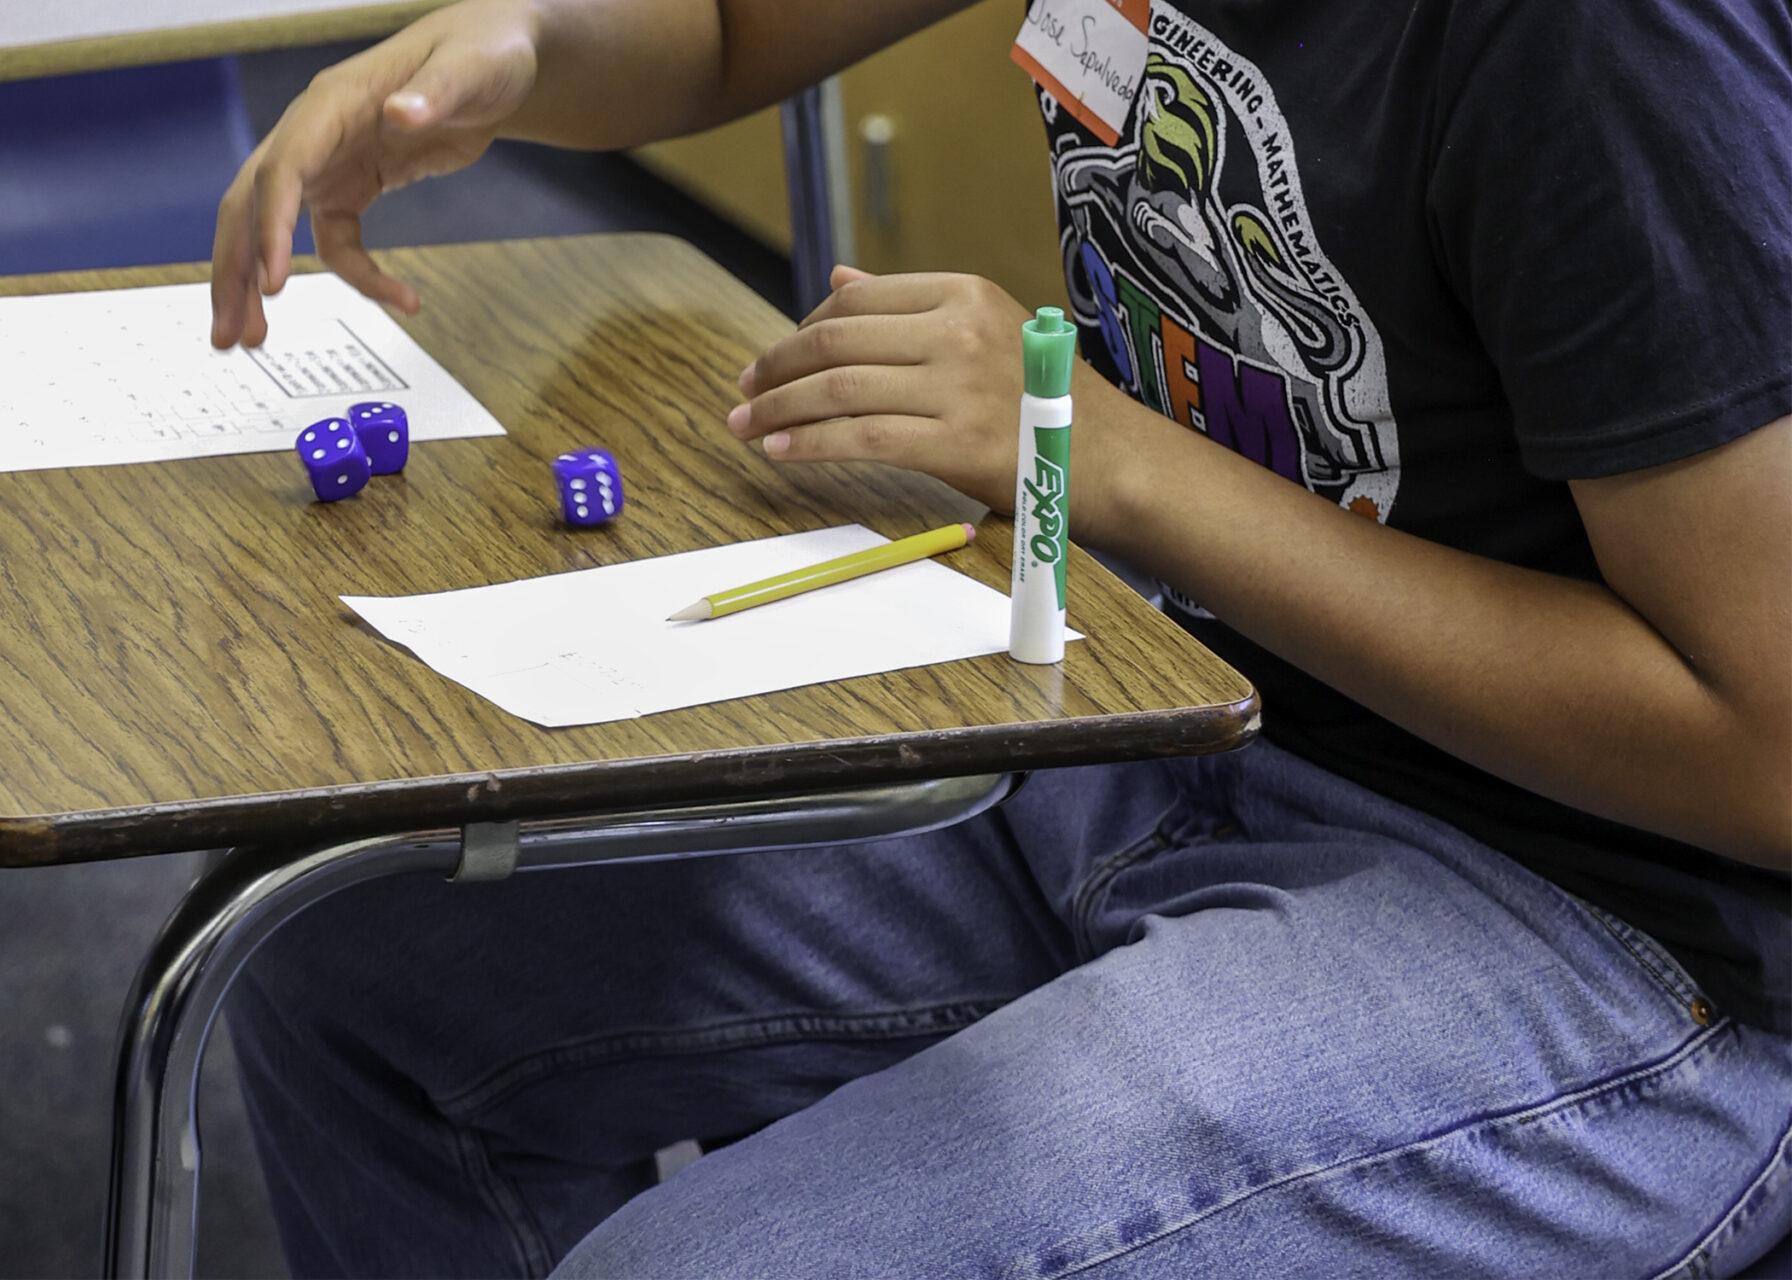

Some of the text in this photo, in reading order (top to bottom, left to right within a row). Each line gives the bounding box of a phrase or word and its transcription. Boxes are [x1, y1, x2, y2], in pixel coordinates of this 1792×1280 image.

[1149, 7, 1264, 114] GINEERING
[1080, 238, 1301, 484] STEM
[1023, 455, 1063, 564] EXPO
